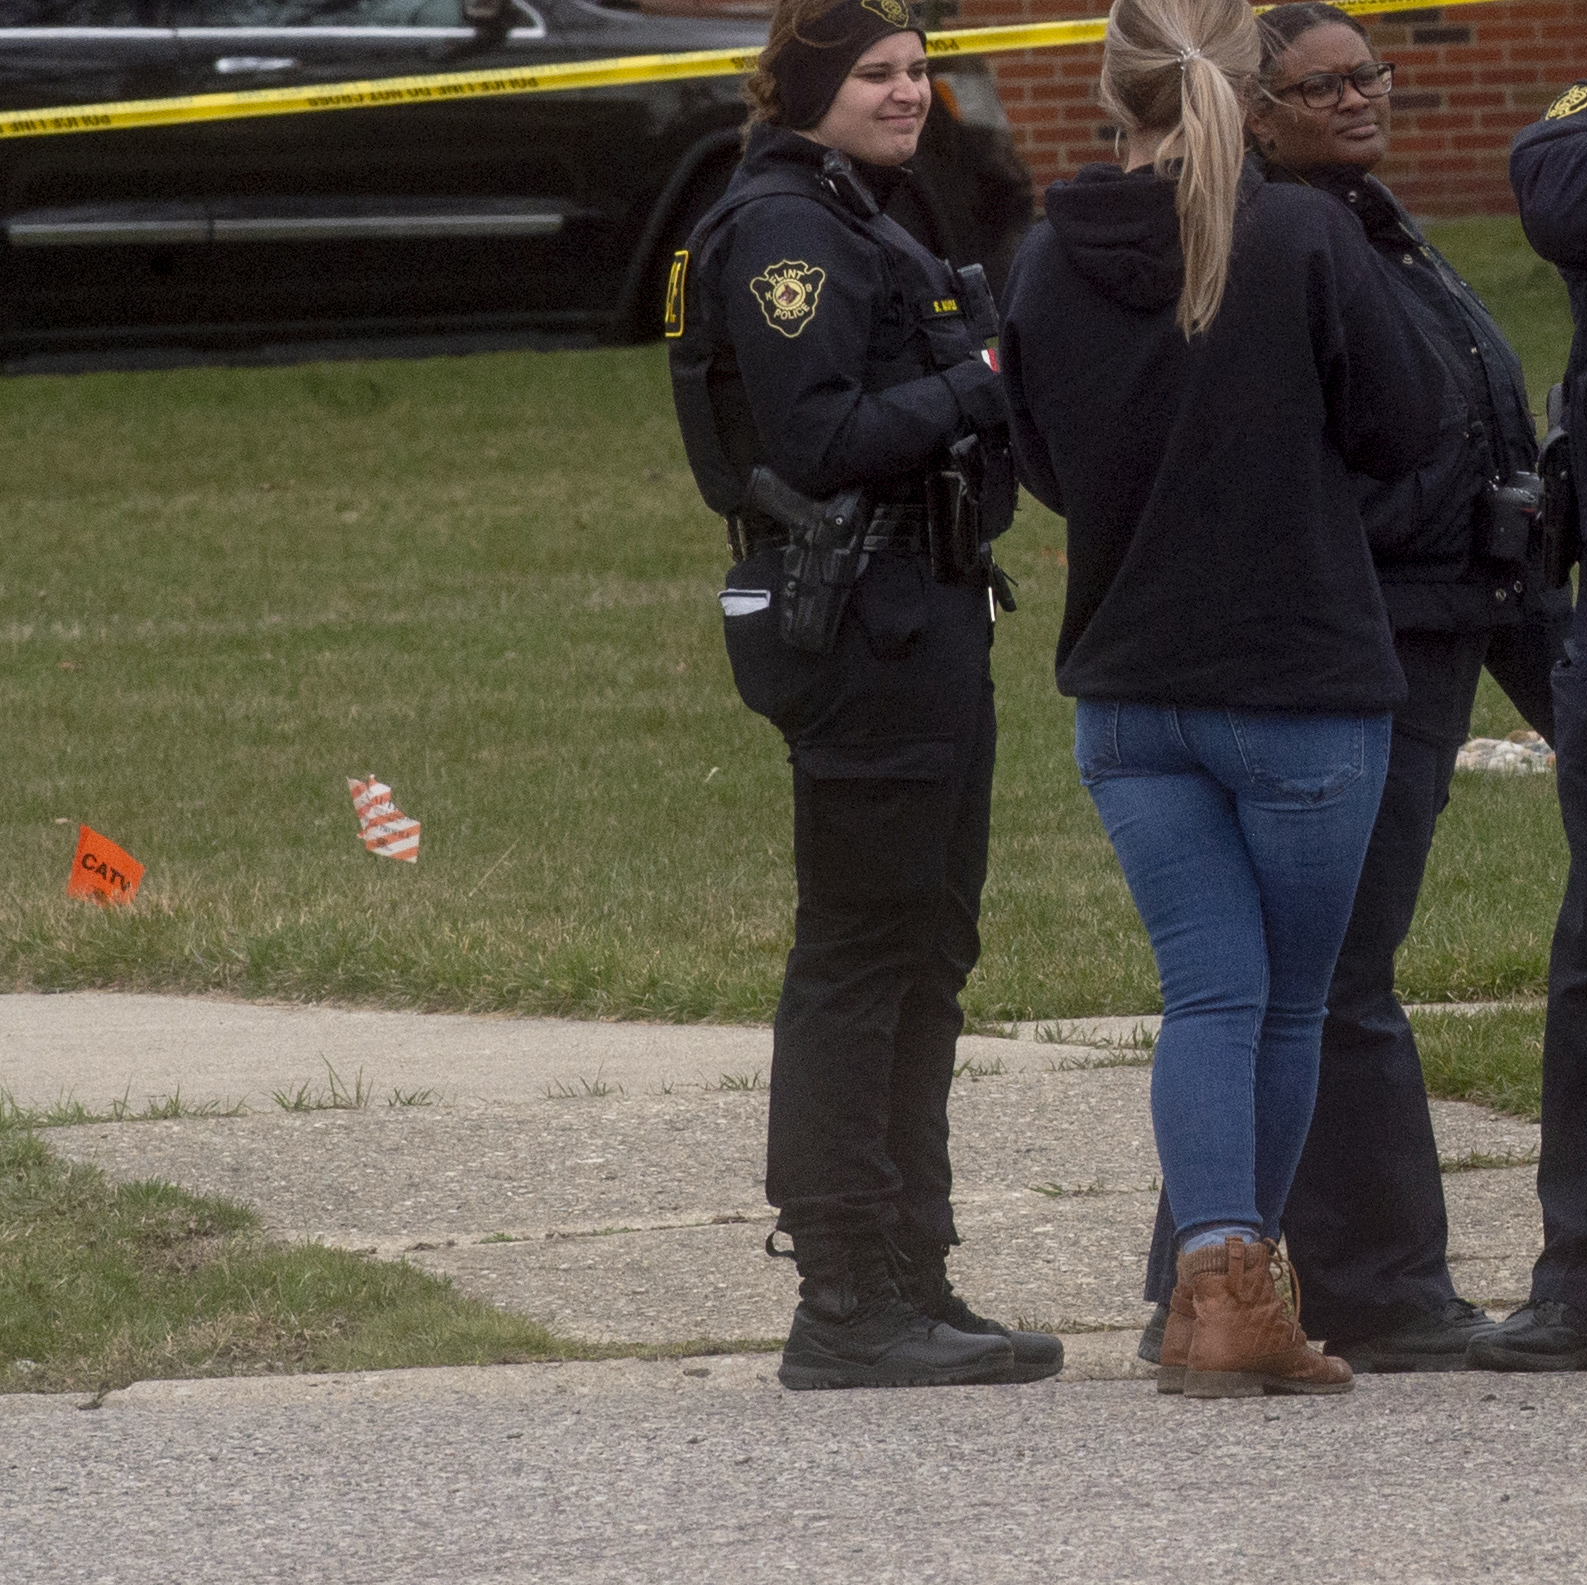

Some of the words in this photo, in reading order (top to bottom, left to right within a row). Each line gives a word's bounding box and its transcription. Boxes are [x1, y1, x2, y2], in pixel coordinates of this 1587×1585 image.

[768, 268, 806, 287] FLINT
[772, 302, 811, 321] POLICE
[81, 853, 131, 892] CATV
